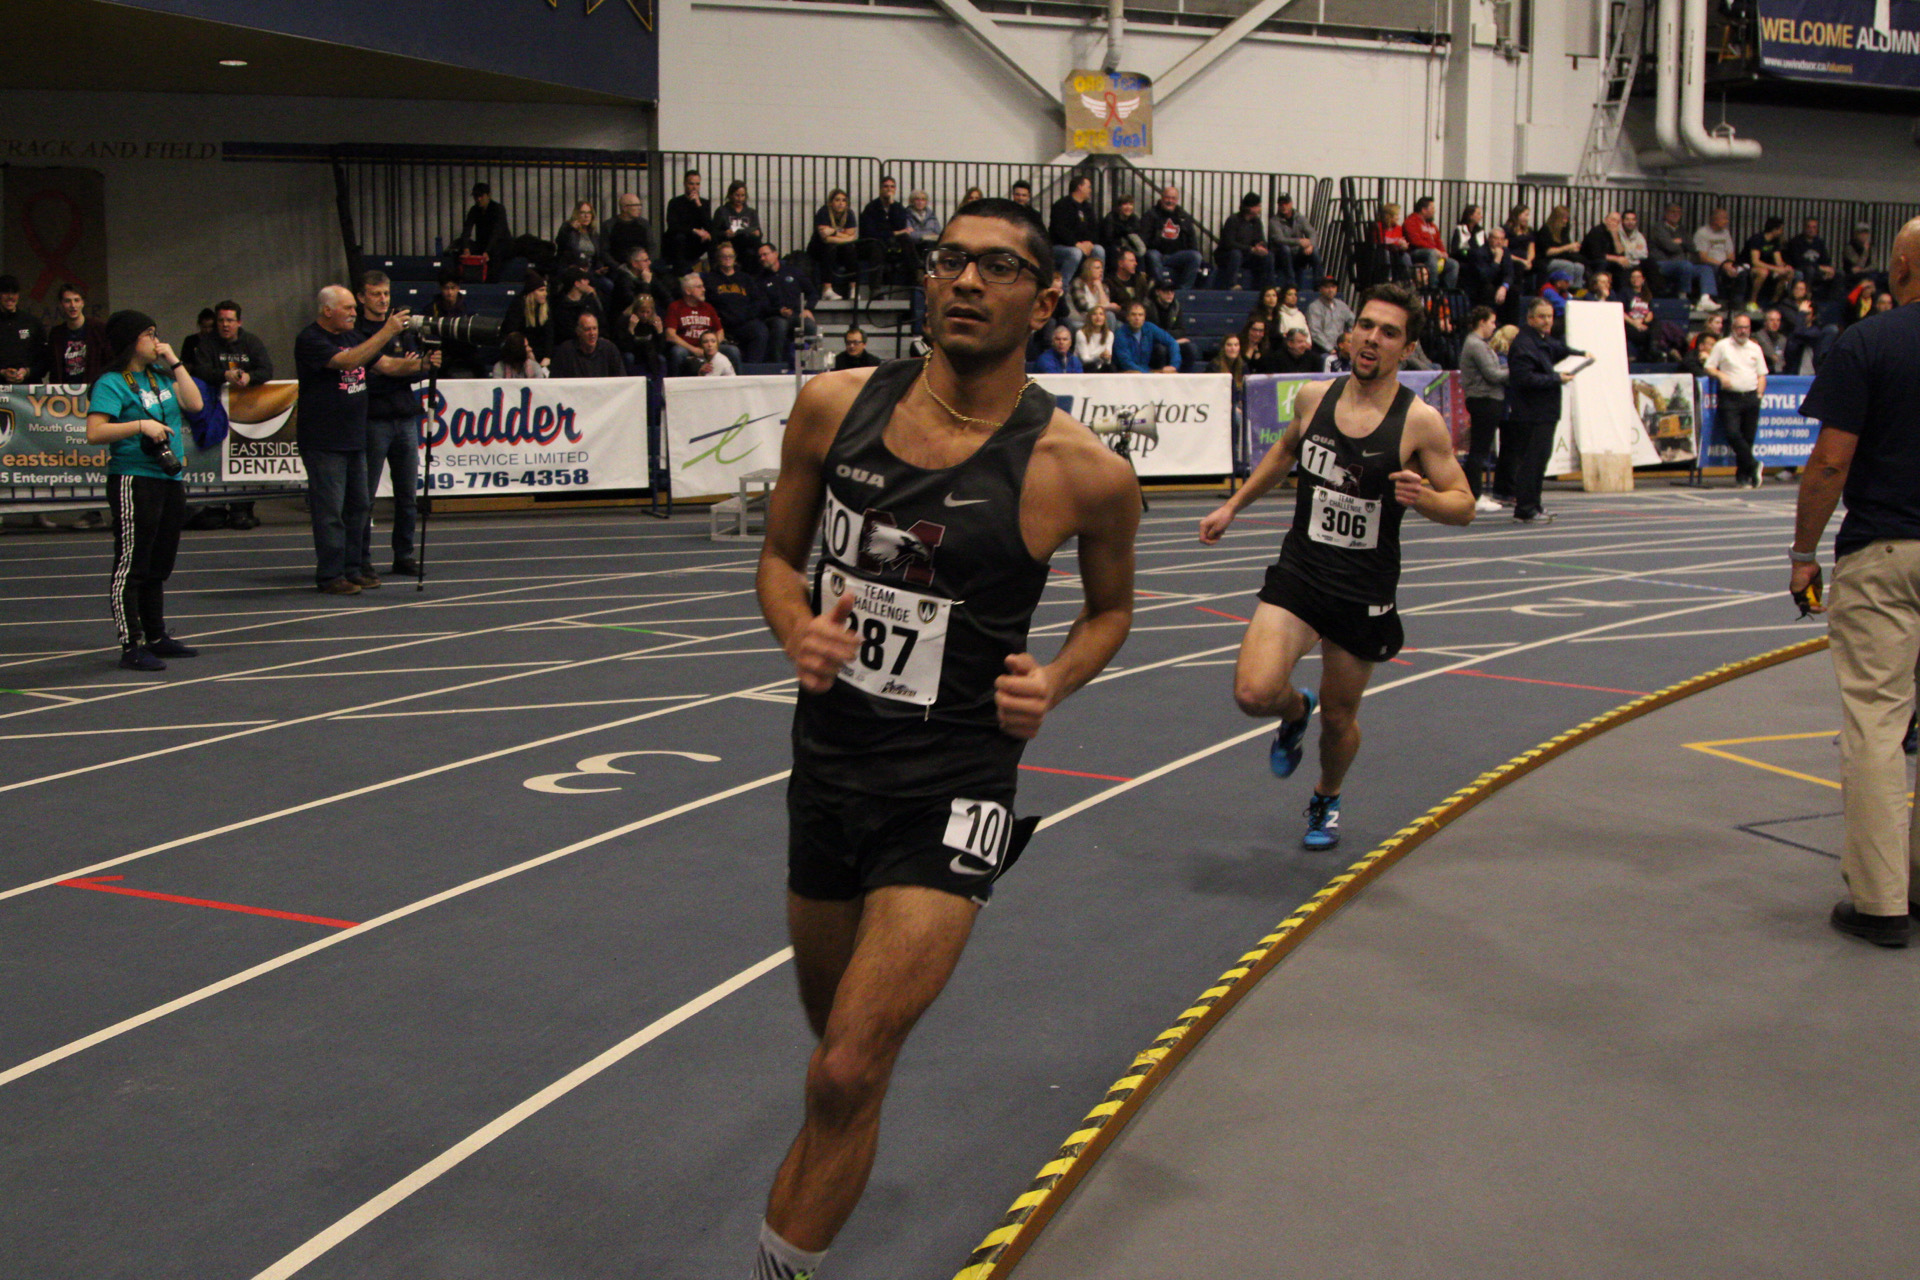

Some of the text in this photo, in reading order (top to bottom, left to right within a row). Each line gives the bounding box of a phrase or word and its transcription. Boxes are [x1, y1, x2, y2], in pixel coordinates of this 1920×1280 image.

[1761, 16, 1854, 48] WELCOME
[1112, 123, 1146, 148] Goal
[81, 141, 138, 159] AND
[144, 142, 217, 160] FIELD
[681, 315, 711, 327] DETROIT
[414, 386, 583, 450] Badder
[1771, 417, 1804, 426] DOUGALL
[29, 423, 62, 432] Mouth
[1312, 434, 1336, 447] OUA
[230, 442, 299, 457] EASTSIDE
[229, 459, 301, 475] DENTAL
[446, 453, 519, 467] SERVICE
[524, 451, 589, 464] LIMITED
[1307, 445, 1328, 475] 11
[13, 472, 82, 485] Enterprise
[836, 464, 885, 488] OUA
[1329, 499, 1362, 513] CHALLENGE
[1339, 494, 1355, 505] TEAM
[1321, 506, 1367, 539] 306
[864, 583, 896, 604] TEAM
[853, 596, 911, 623] HALLENGE
[966, 802, 1000, 857] 10
